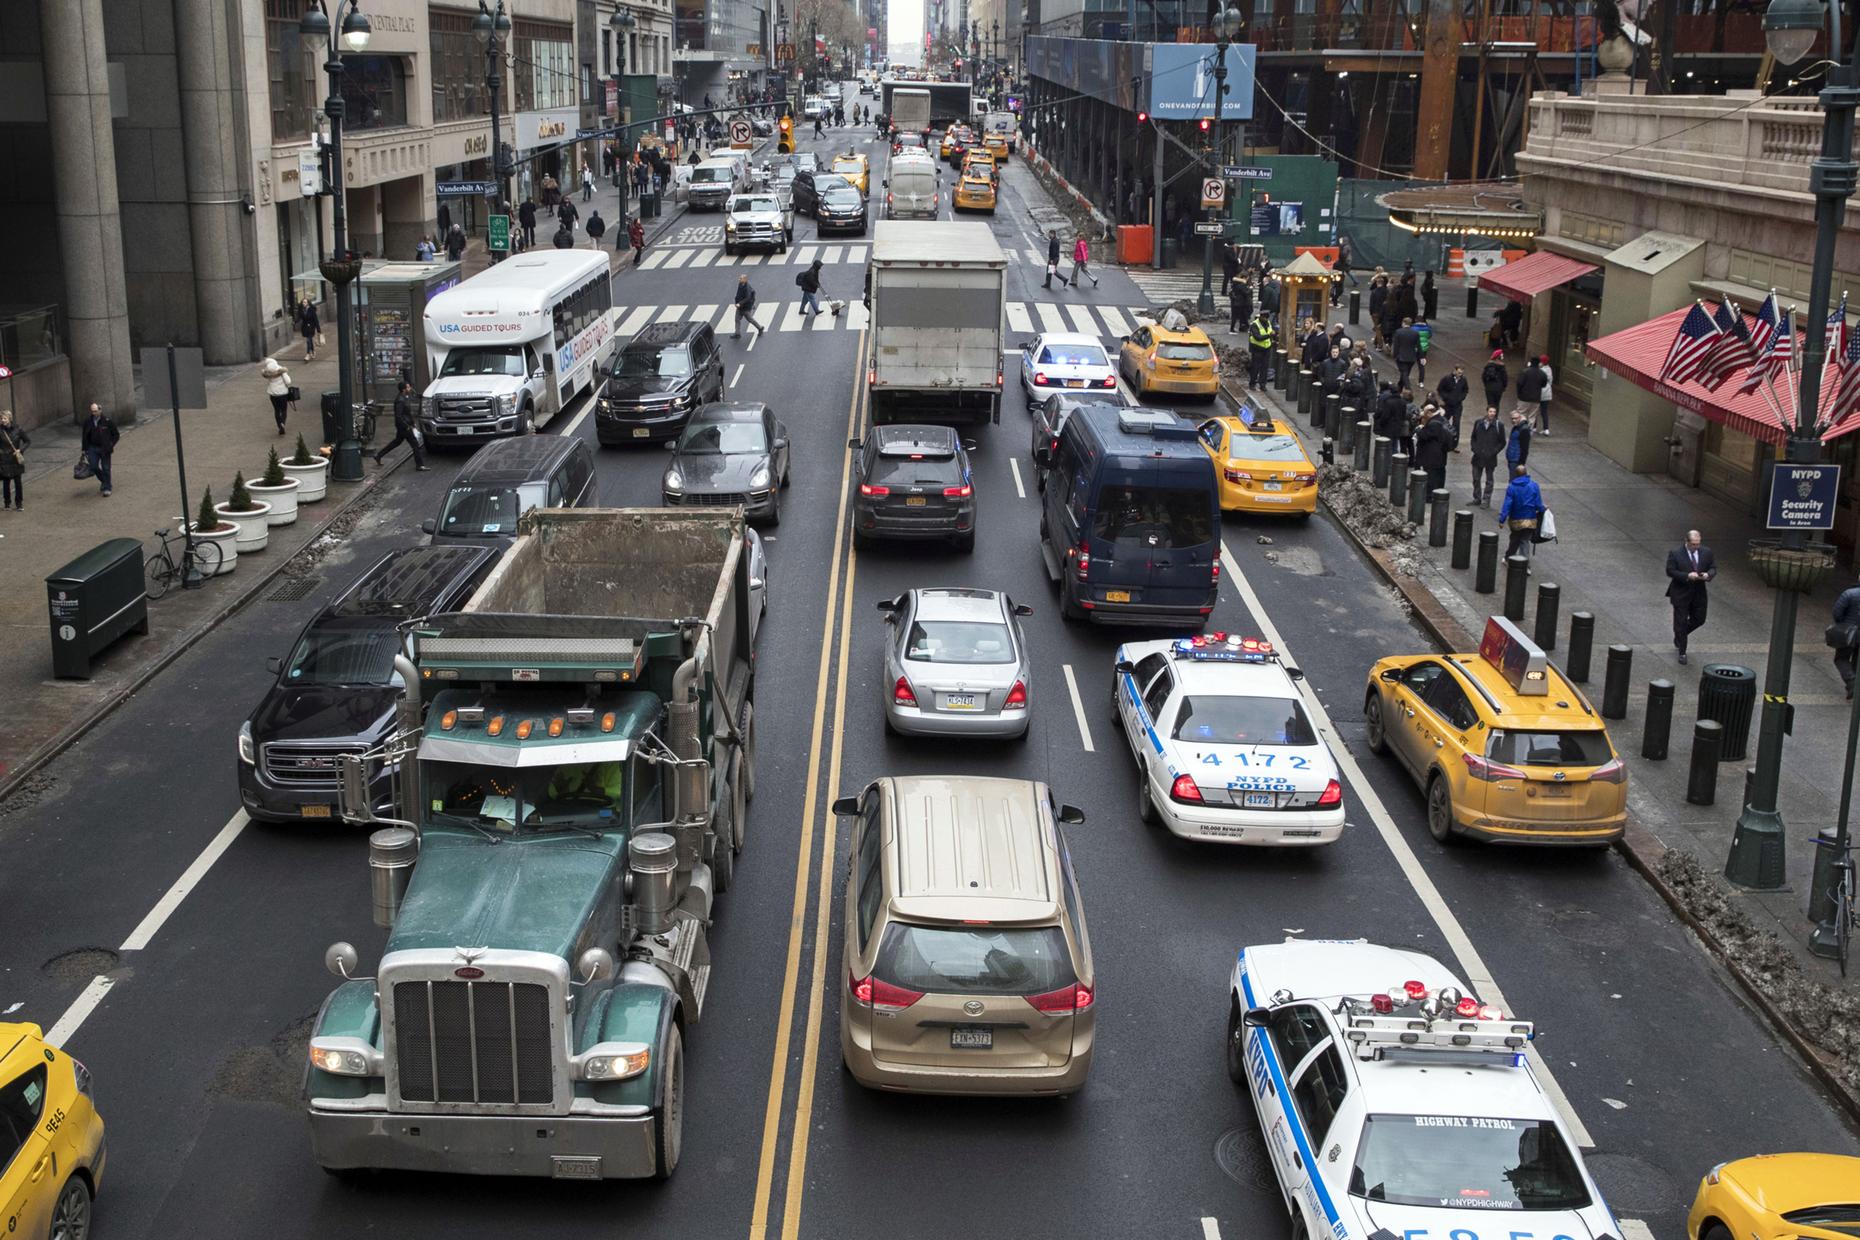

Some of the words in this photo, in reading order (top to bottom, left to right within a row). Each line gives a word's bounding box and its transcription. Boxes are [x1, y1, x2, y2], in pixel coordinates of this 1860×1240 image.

[1158, 102, 1241, 110] ONEVANDERBIL.COM
[1224, 168, 1257, 176] Vanderbilt
[1257, 169, 1271, 177] Ave
[438, 184, 474, 193] Vanderbilt
[440, 324, 461, 333] USA
[461, 324, 492, 333] GUIDED
[494, 323, 522, 333] TOURS
[559, 341, 575, 373] USA
[573, 327, 594, 361] GUIDED
[1791, 470, 1822, 480] NYPD
[1781, 500, 1824, 512] Security
[1781, 510, 1822, 519] Camera
[1202, 752, 1312, 770] 4172
[1235, 776, 1289, 784] NYPD
[1226, 783, 1296, 791] POLICE
[1246, 795, 1269, 805] 4172
[1247, 1029, 1269, 1100] NYPD
[45, 1108, 66, 1133] 9E45
[1414, 1116, 1468, 1128] HIGHWAY
[1472, 1117, 1516, 1130] PATROL
[1449, 1198, 1513, 1209] @NYPDHIGHWAY
